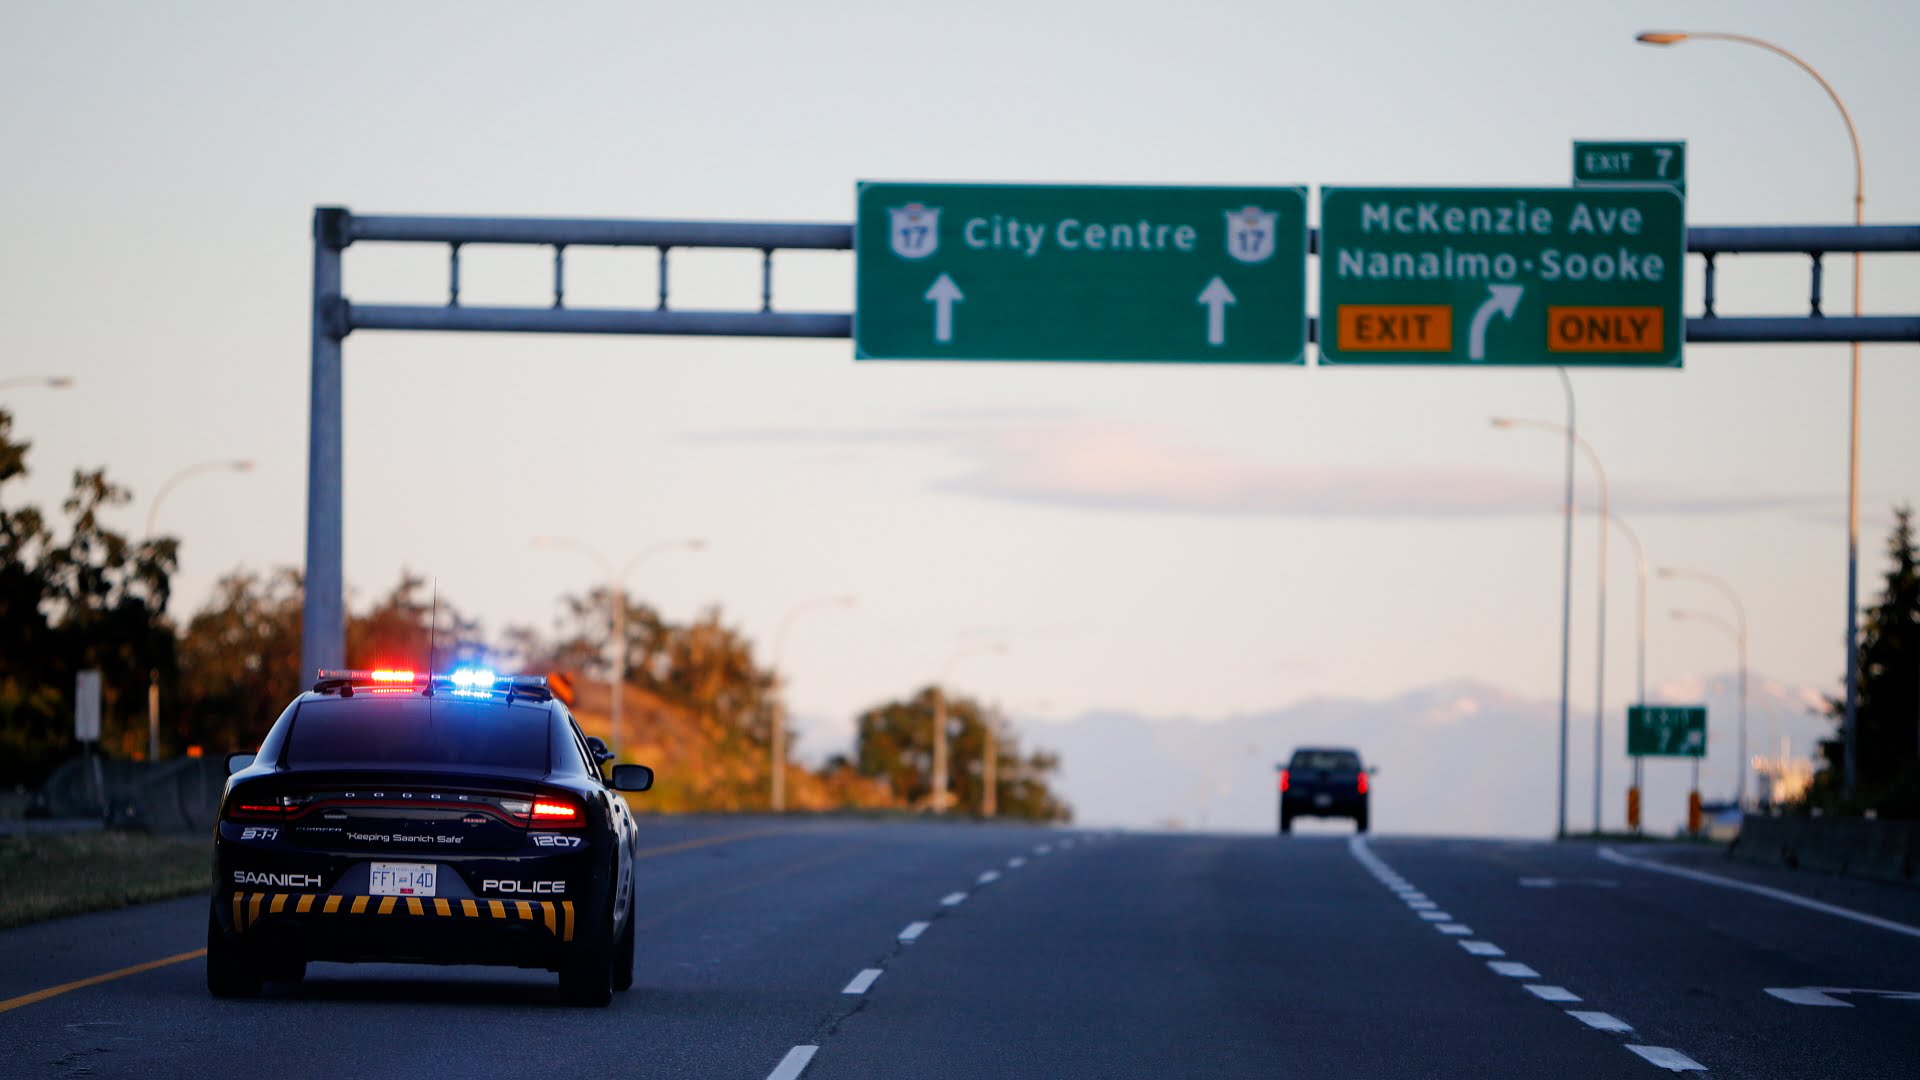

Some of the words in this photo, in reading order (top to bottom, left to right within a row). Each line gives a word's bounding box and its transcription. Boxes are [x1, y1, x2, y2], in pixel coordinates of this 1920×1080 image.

[1584, 153, 1632, 173] EXIT
[1653, 149, 1673, 177] 7
[1361, 201, 1553, 235] McKenzie
[1568, 203, 1643, 234] Ave
[901, 226, 928, 250] 17
[964, 215, 1045, 257] City
[1055, 219, 1196, 250] Centre
[1239, 230, 1266, 254] 17
[1355, 314, 1433, 343] EXIT
[1558, 315, 1651, 345] ONLY
[393, 834, 434, 843] Saanich
[533, 836, 581, 847] 1207
[234, 871, 322, 887] SAANICH
[482, 880, 566, 893] POLICE
